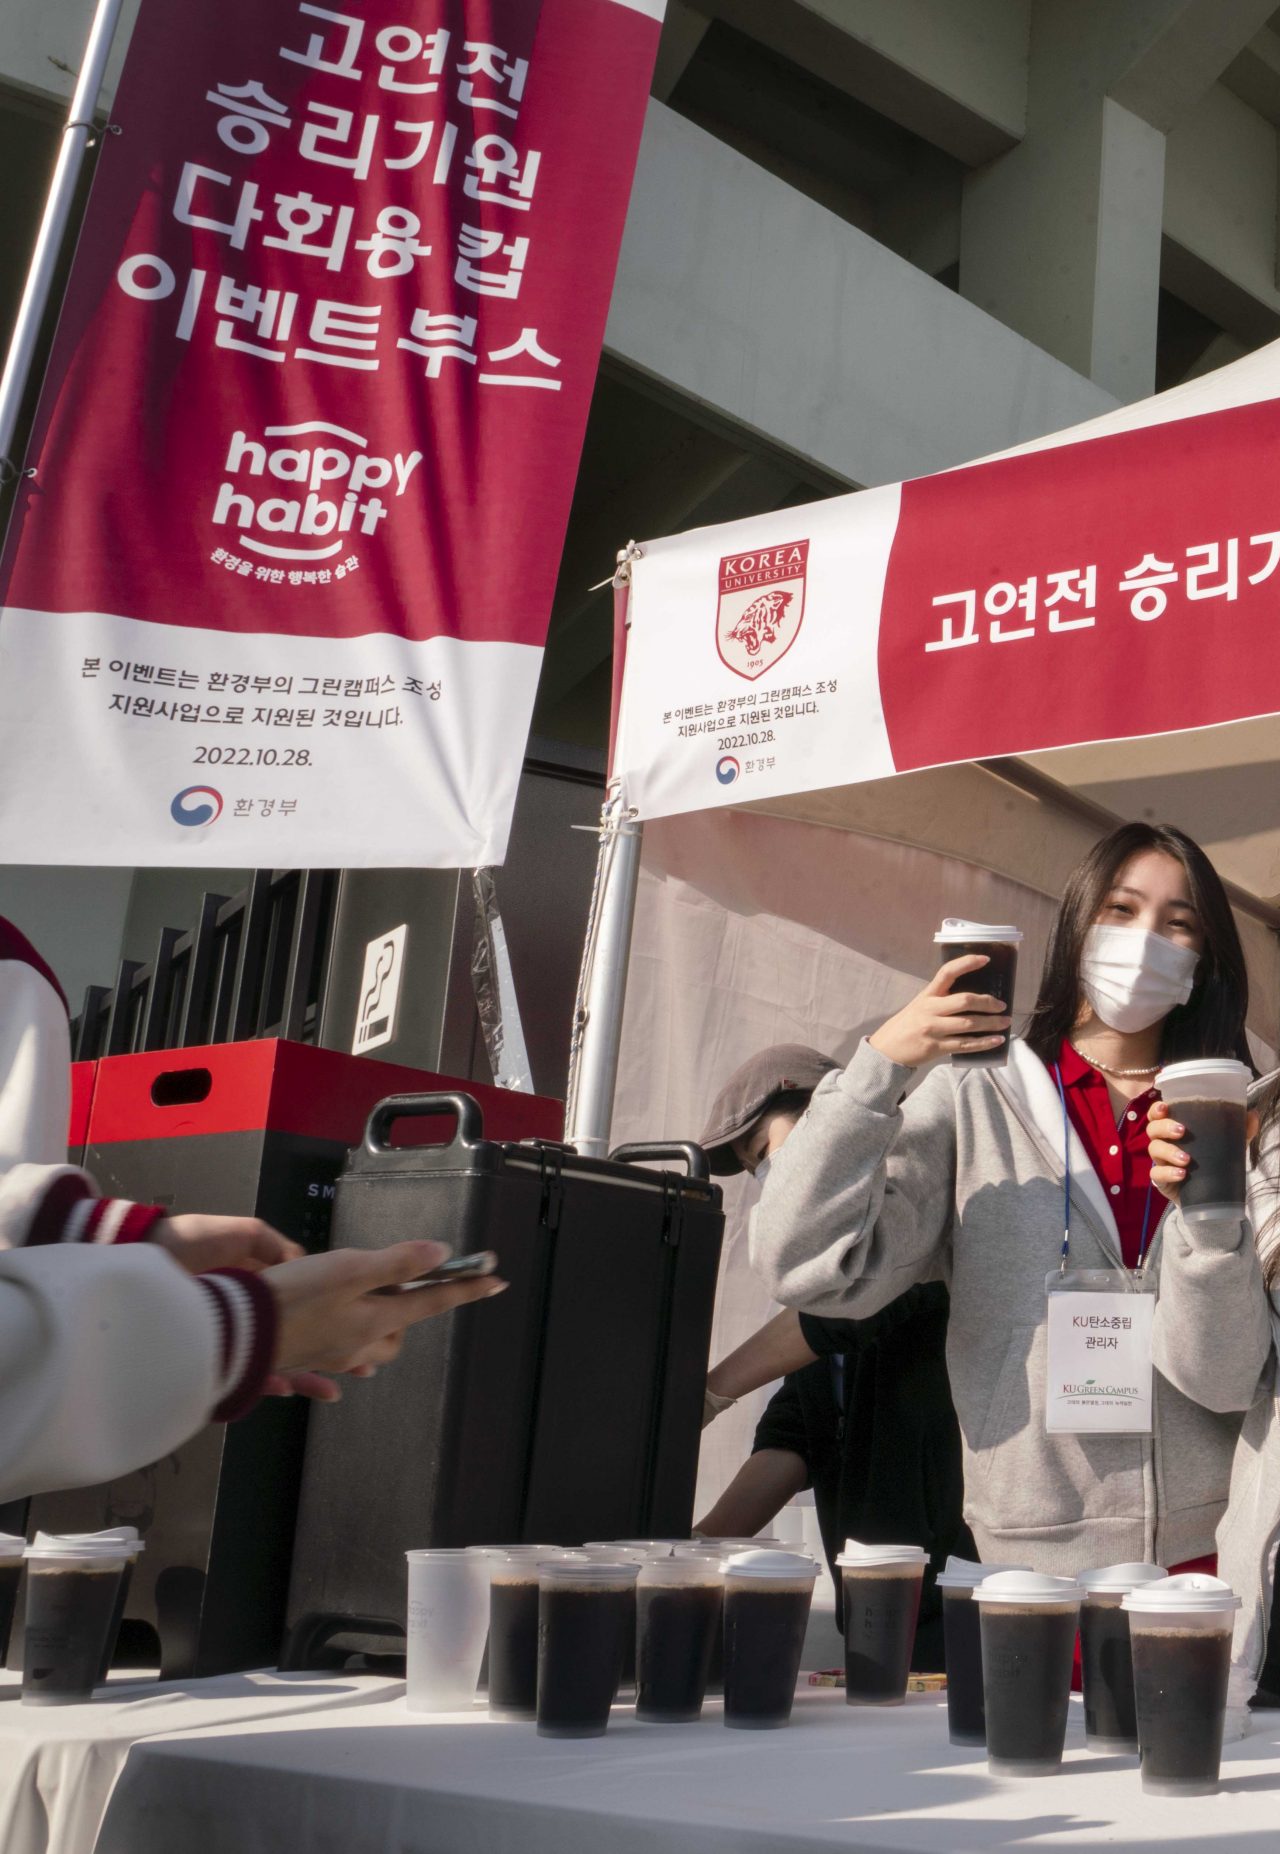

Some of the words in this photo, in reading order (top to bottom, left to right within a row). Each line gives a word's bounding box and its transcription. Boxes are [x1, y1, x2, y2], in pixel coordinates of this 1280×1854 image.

[279, 2, 530, 119] 고연전
[206, 79, 541, 211] 승리기원
[173, 161, 432, 278] 다회용
[454, 223, 530, 299] 컵
[117, 253, 382, 371] 이벤트
[396, 308, 562, 391] 부스
[225, 430, 423, 496] happy
[212, 483, 388, 536] habit
[210, 547, 254, 577] 환경을
[254, 566, 285, 584] 위한
[287, 569, 332, 585] 행복한
[334, 555, 360, 580] 습관
[725, 547, 802, 576] KOREA
[725, 564, 801, 589] UNIVERSITY
[924, 565, 1098, 653] 고연전
[81, 657, 101, 678] 본
[108, 660, 200, 690] 이벤트는
[207, 672, 294, 695] 환경부의
[298, 674, 396, 698] 그린캠퍼스
[402, 676, 442, 701] 조성
[747, 659, 764, 669] 1905
[108, 693, 245, 725] 지원사업으로
[251, 707, 316, 728] 지원된
[322, 706, 404, 728] 것입니다.
[662, 711, 672, 724] 본
[674, 704, 714, 721] 이벤트는
[717, 693, 757, 713] 환경부의
[759, 684, 812, 704] 그린캠퍼스
[815, 679, 838, 694] 조성
[678, 716, 736, 738] 지원사업으로
[739, 709, 771, 725] 지원된
[774, 701, 819, 720] 것입니다.
[192, 746, 313, 767] 2022.10.28.
[718, 730, 776, 750] 2022.10.28.
[745, 757, 776, 773] 환경부
[233, 797, 298, 818] 환경부
[1072, 1316, 1132, 1329] KU탄소중립
[1085, 1337, 1118, 1350] 관리자
